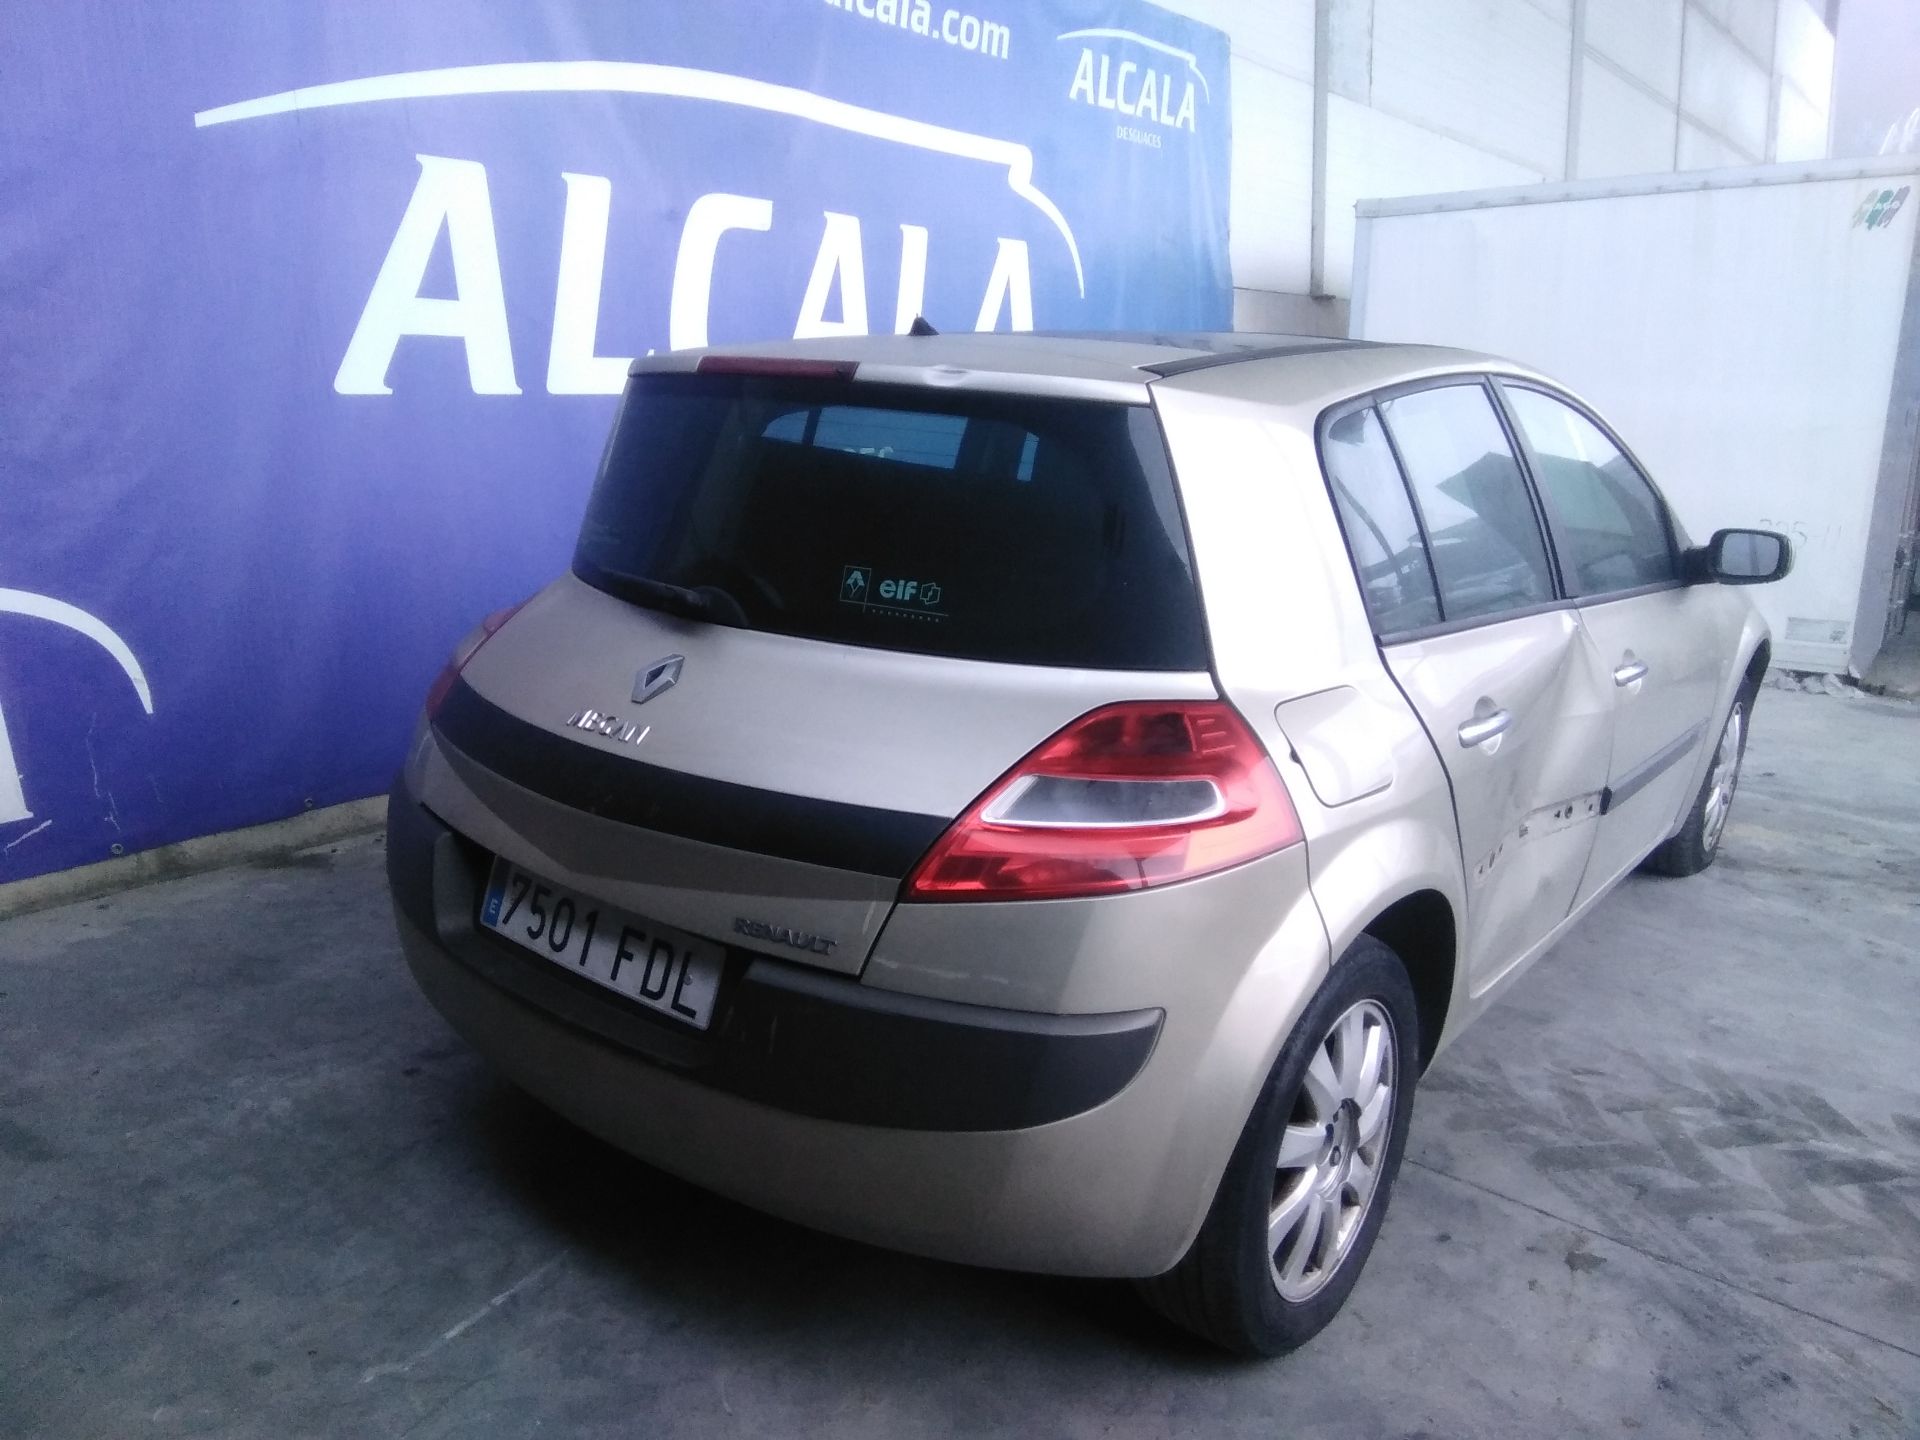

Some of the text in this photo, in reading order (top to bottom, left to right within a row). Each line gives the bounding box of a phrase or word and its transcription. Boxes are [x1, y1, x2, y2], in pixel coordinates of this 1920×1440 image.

[822, 0, 1010, 60] cala.com
[1069, 47, 1196, 133] ALCALA
[1116, 125, 1162, 148] DESGUACES
[879, 578, 918, 601] elf
[502, 872, 697, 1020] 7501 FDL
[735, 917, 839, 955] RENAULT
